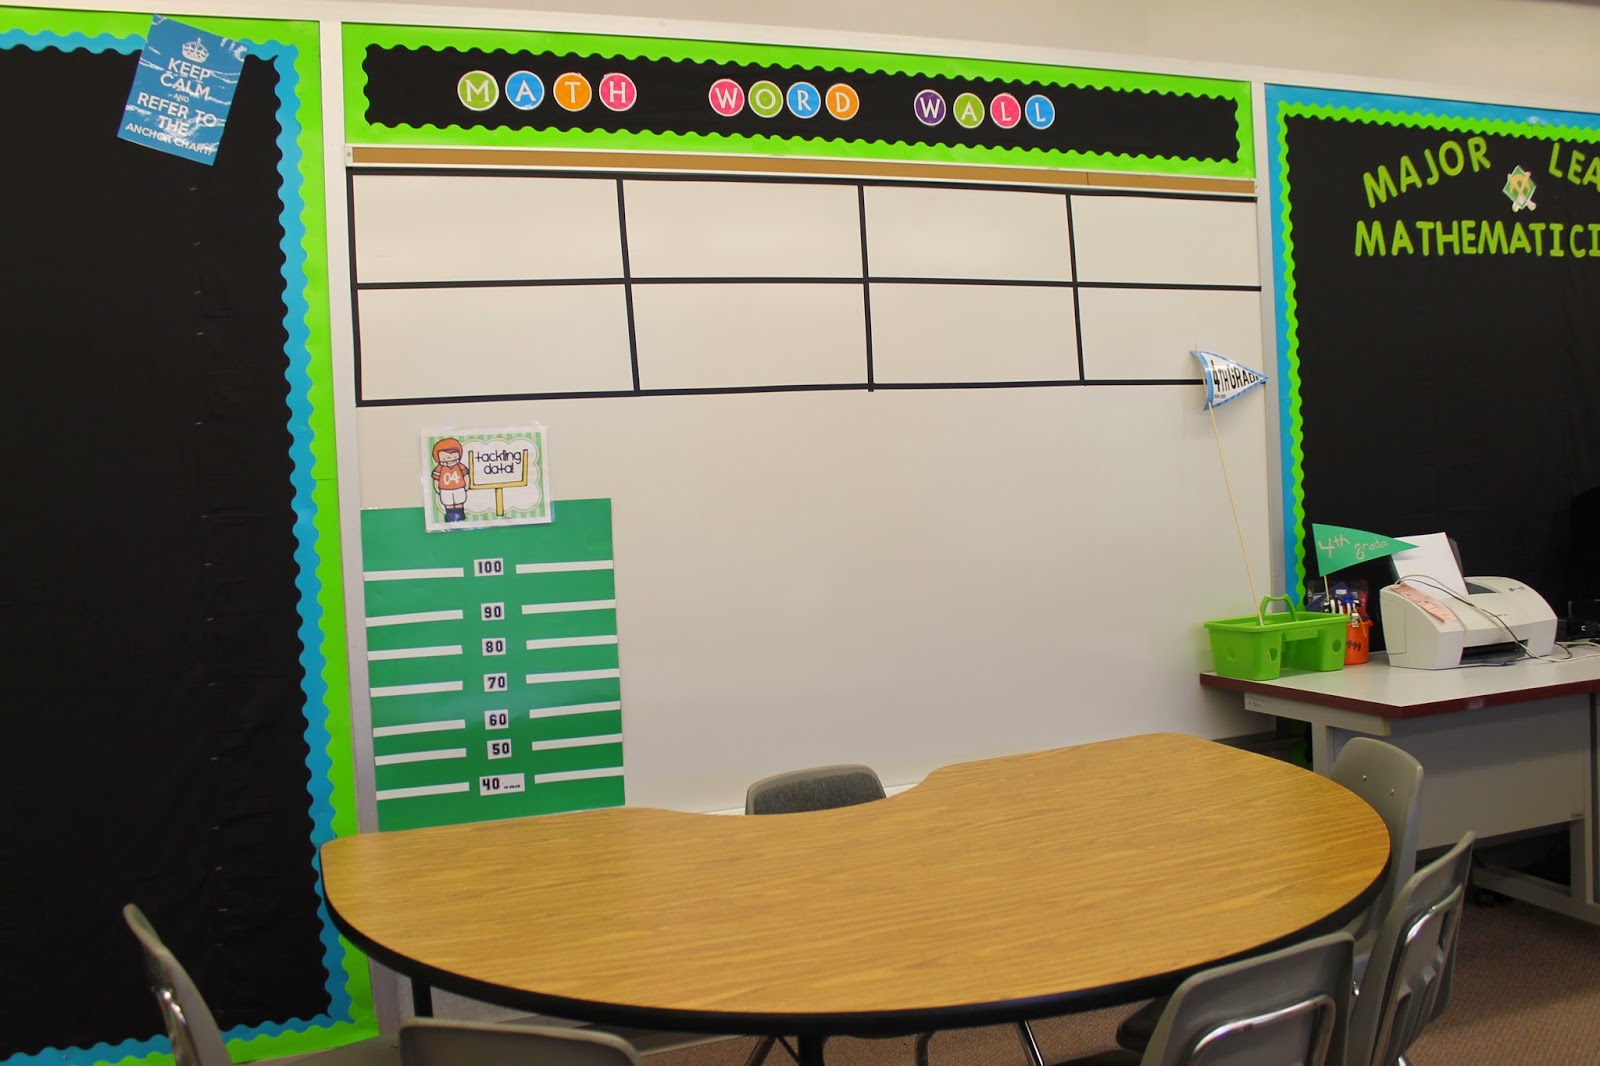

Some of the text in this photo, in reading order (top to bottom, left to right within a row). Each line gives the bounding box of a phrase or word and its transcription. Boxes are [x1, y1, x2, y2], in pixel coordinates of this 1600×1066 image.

[168, 57, 211, 81] KEEP
[160, 73, 210, 100] CALM
[173, 93, 190, 103] AND
[464, 78, 1048, 123] MATH WORD WALL
[137, 92, 217, 127] REFER TO
[125, 122, 172, 144] ANCHOR
[158, 114, 190, 137] THE
[1363, 136, 1600, 209] MAJOR LEA
[1354, 219, 1600, 258] MATHEMATICI
[475, 449, 522, 465] tackling
[443, 471, 461, 486] 04
[1317, 534, 1389, 560] 4th grade
[477, 560, 502, 574] 100
[484, 605, 502, 619] 90
[485, 640, 503, 653] 80
[487, 676, 506, 689] 70
[489, 713, 507, 727] 60
[492, 742, 510, 756] 50
[482, 777, 500, 791] 40
